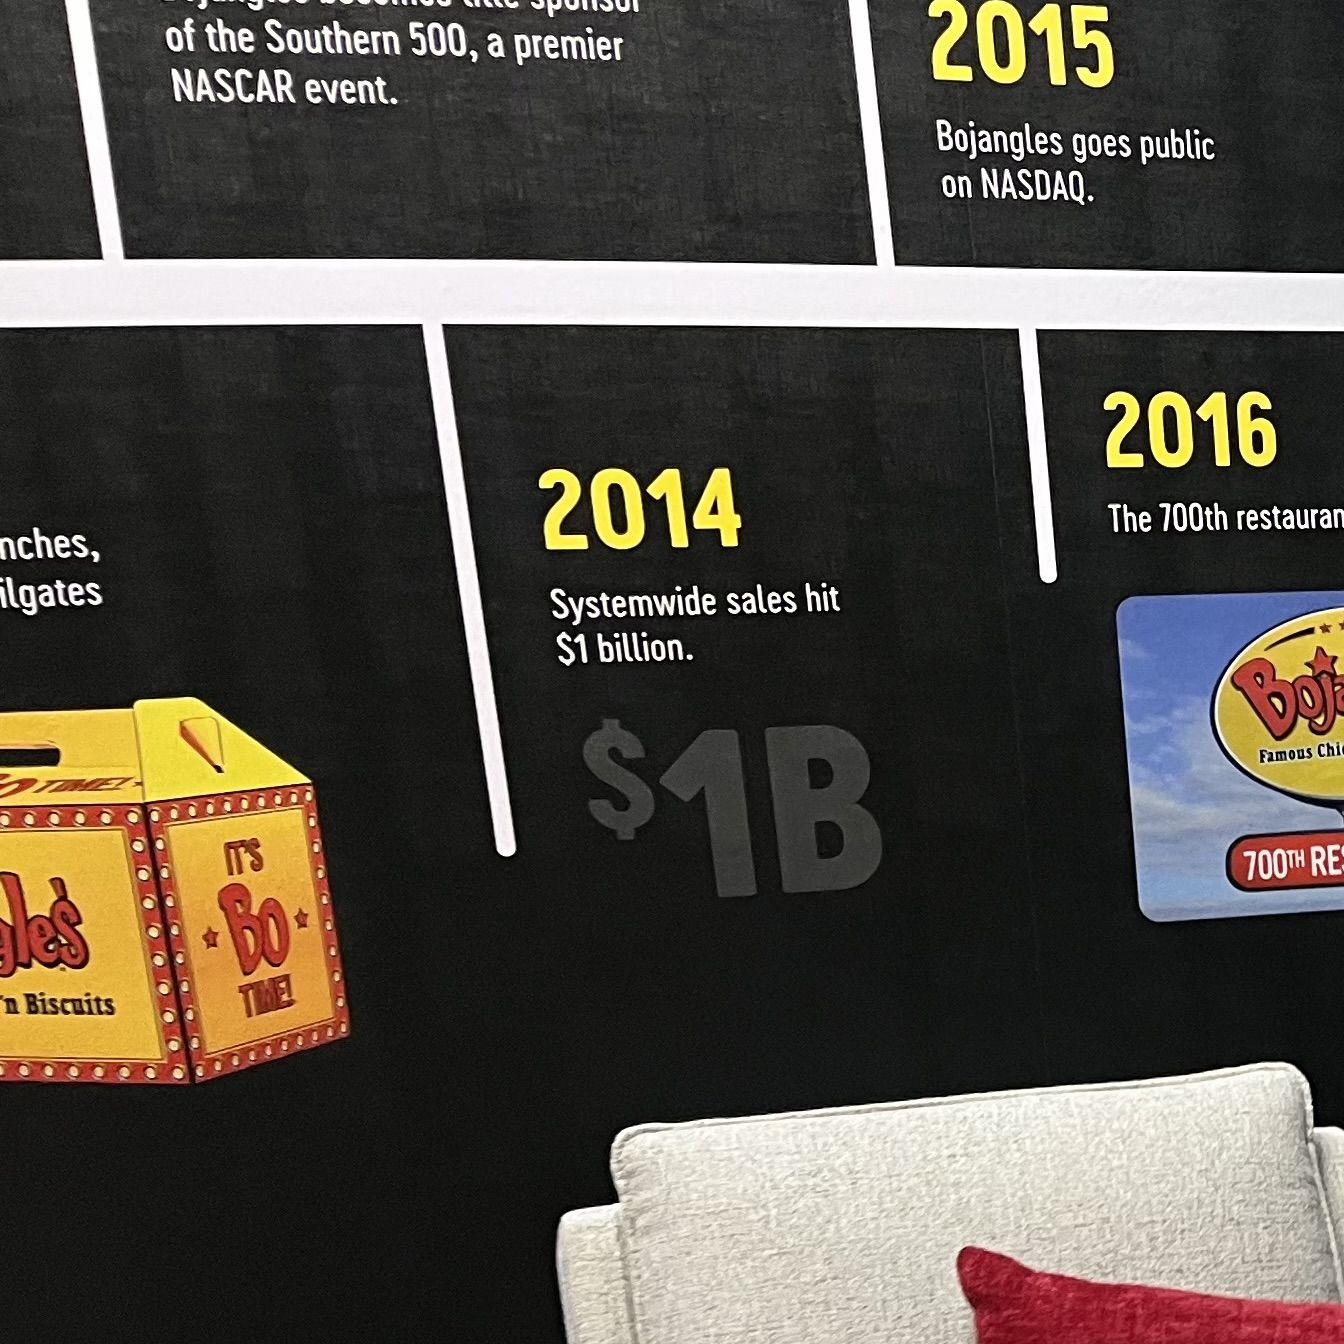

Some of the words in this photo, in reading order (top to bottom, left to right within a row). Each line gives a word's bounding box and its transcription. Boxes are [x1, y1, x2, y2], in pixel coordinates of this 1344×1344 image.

[165, 17, 196, 53] of
[204, 17, 255, 53] the
[264, 18, 401, 56] Southern
[408, 21, 479, 63] 500,
[487, 32, 506, 58] a
[513, 26, 624, 66] premier
[927, 0, 1115, 88] 2015
[170, 67, 297, 104] NASCAR
[304, 76, 398, 105] event.
[936, 119, 1064, 162] Bojangles
[1072, 133, 1132, 164] goes
[1140, 128, 1216, 166] public
[941, 174, 973, 199] on
[980, 167, 1094, 206] NASDAQ.
[1103, 390, 1277, 468] 2016
[538, 467, 742, 551] 2014
[1107, 503, 1152, 533] The
[1158, 502, 1229, 532] 700th
[550, 585, 717, 626] Systemwide
[726, 583, 798, 615] sales
[805, 582, 841, 612] hit
[556, 631, 588, 667] $1
[596, 631, 694, 663] billion.
[1259, 748, 1313, 764] Famous
[582, 718, 883, 898] $1B
[224, 838, 264, 876] IT'S
[1243, 847, 1306, 881] 700TH
[24, 991, 116, 1015] Biscuits
